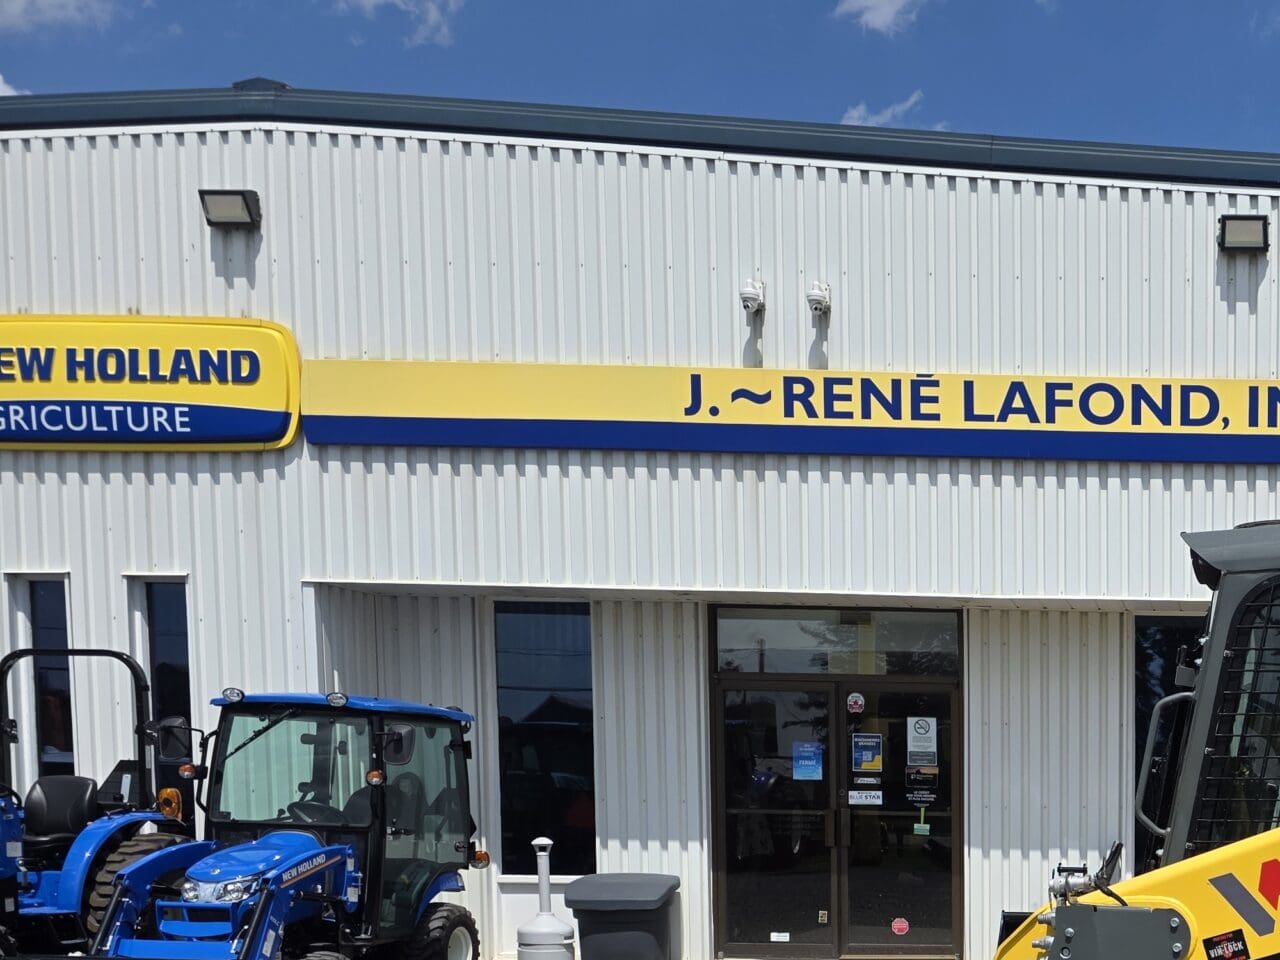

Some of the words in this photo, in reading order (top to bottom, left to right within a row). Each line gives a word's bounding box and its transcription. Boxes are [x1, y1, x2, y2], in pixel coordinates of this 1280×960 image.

[66, 348, 261, 385] HOLLAND
[0, 405, 191, 433] RICULTURE
[962, 379, 1231, 431] LAFOND,
[282, 866, 298, 882] NEW
[297, 854, 326, 874] HOLLAND
